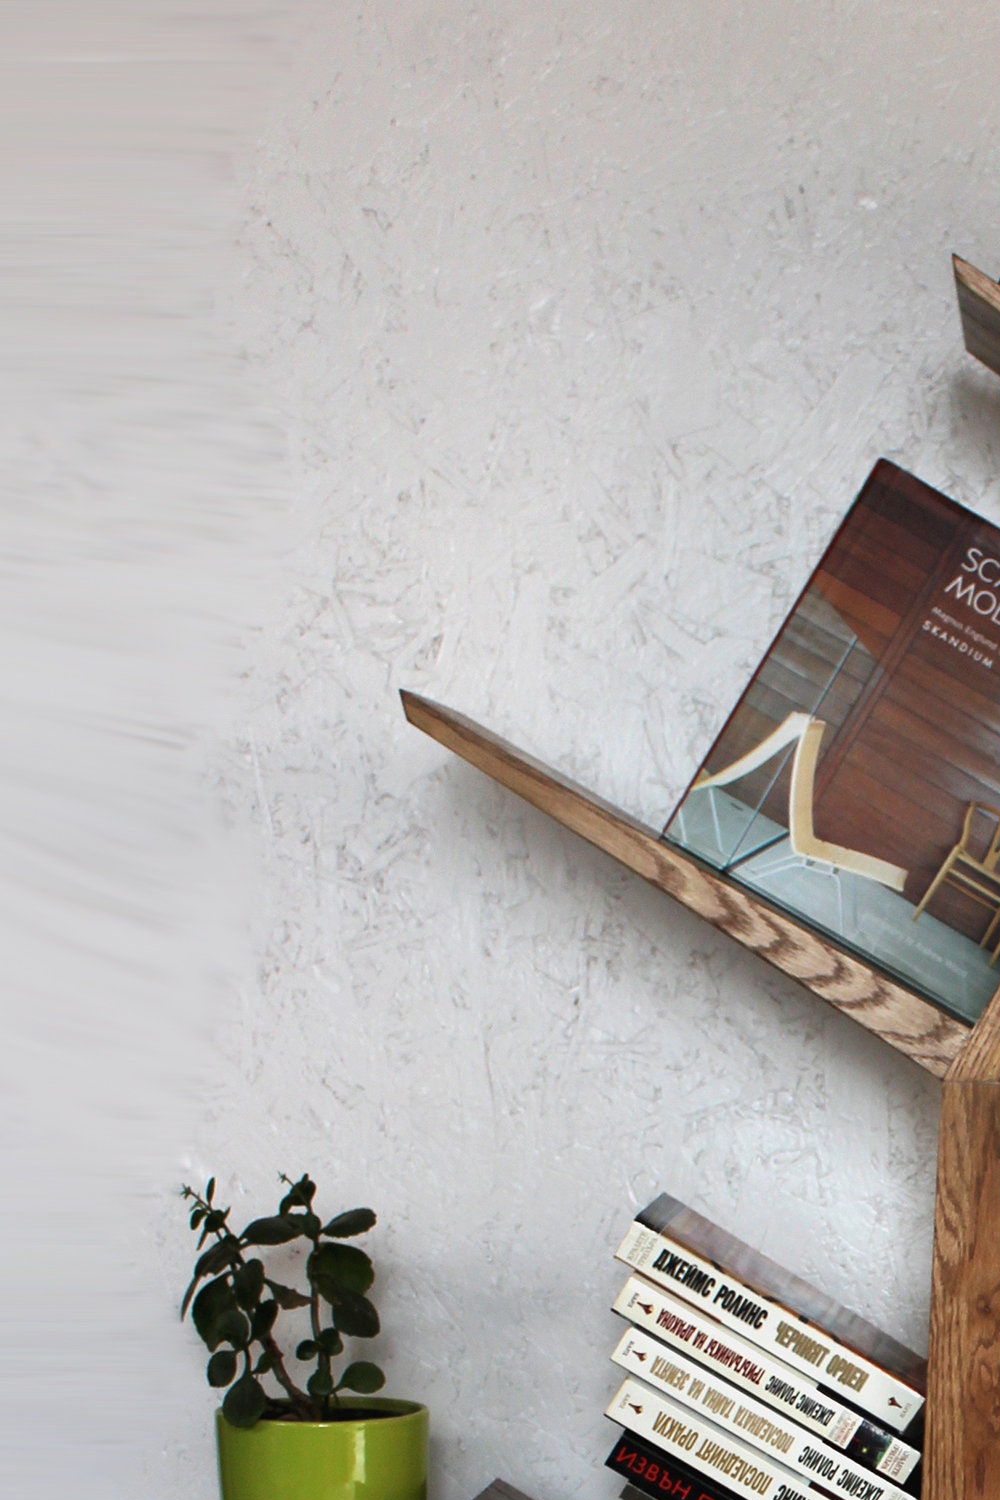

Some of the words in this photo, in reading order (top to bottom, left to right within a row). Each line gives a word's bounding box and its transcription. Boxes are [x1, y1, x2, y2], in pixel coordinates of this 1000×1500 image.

[923, 620, 992, 668] SKANDIUM
[653, 1249, 716, 1297] ДЖЕЙМС
[713, 1285, 768, 1329] РОЛИНС
[775, 1321, 830, 1367] ЧЕРНИЯТ
[826, 1355, 869, 1392] ОРДЕН
[656, 1309, 696, 1342] ДРАКОНА
[692, 1331, 708, 1349] НА
[650, 1356, 690, 1390] ЗЕМЯТА
[688, 1378, 705, 1400] НА
[702, 1387, 735, 1418] ТАЙНА
[765, 1376, 800, 1405] РОЛИНС
[796, 1394, 835, 1426] ДЖЕЙМС
[652, 1412, 698, 1450] ОРАКУЛ
[733, 1406, 794, 1454] ПОСЛЕДНАТА
[616, 1448, 691, 1500] ИЗВЪН
[696, 1439, 772, 1495] ПОСЛЕДНИЯТ
[798, 1446, 840, 1480] РОЛИНС
